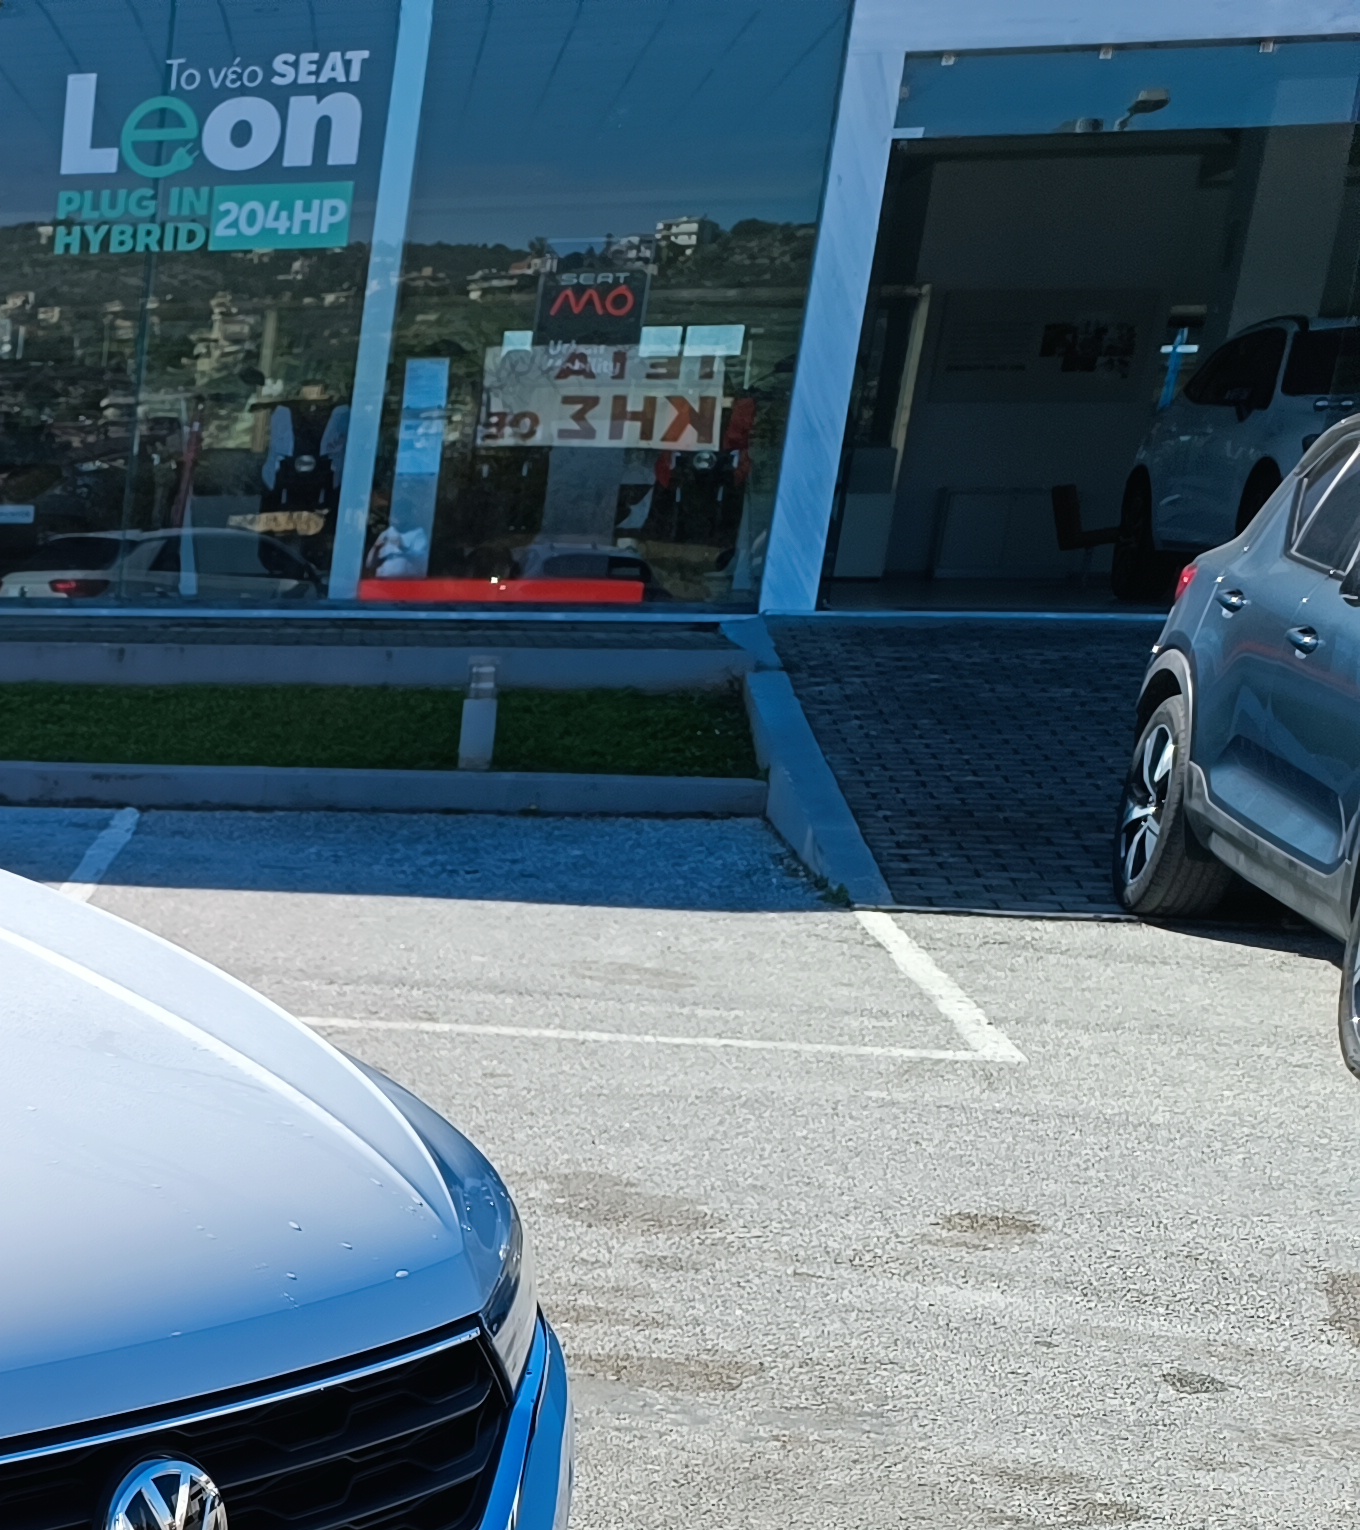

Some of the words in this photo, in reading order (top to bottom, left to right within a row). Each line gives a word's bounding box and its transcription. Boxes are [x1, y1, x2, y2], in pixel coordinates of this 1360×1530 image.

[208, 56, 264, 88] νέο
[270, 50, 370, 86] SEAT
[60, 73, 362, 178] Leon
[56, 187, 157, 220] PLUG
[167, 186, 211, 216] IN
[213, 198, 348, 237] 204HP
[53, 221, 207, 256] HYBRID
[560, 271, 631, 287] SEAT
